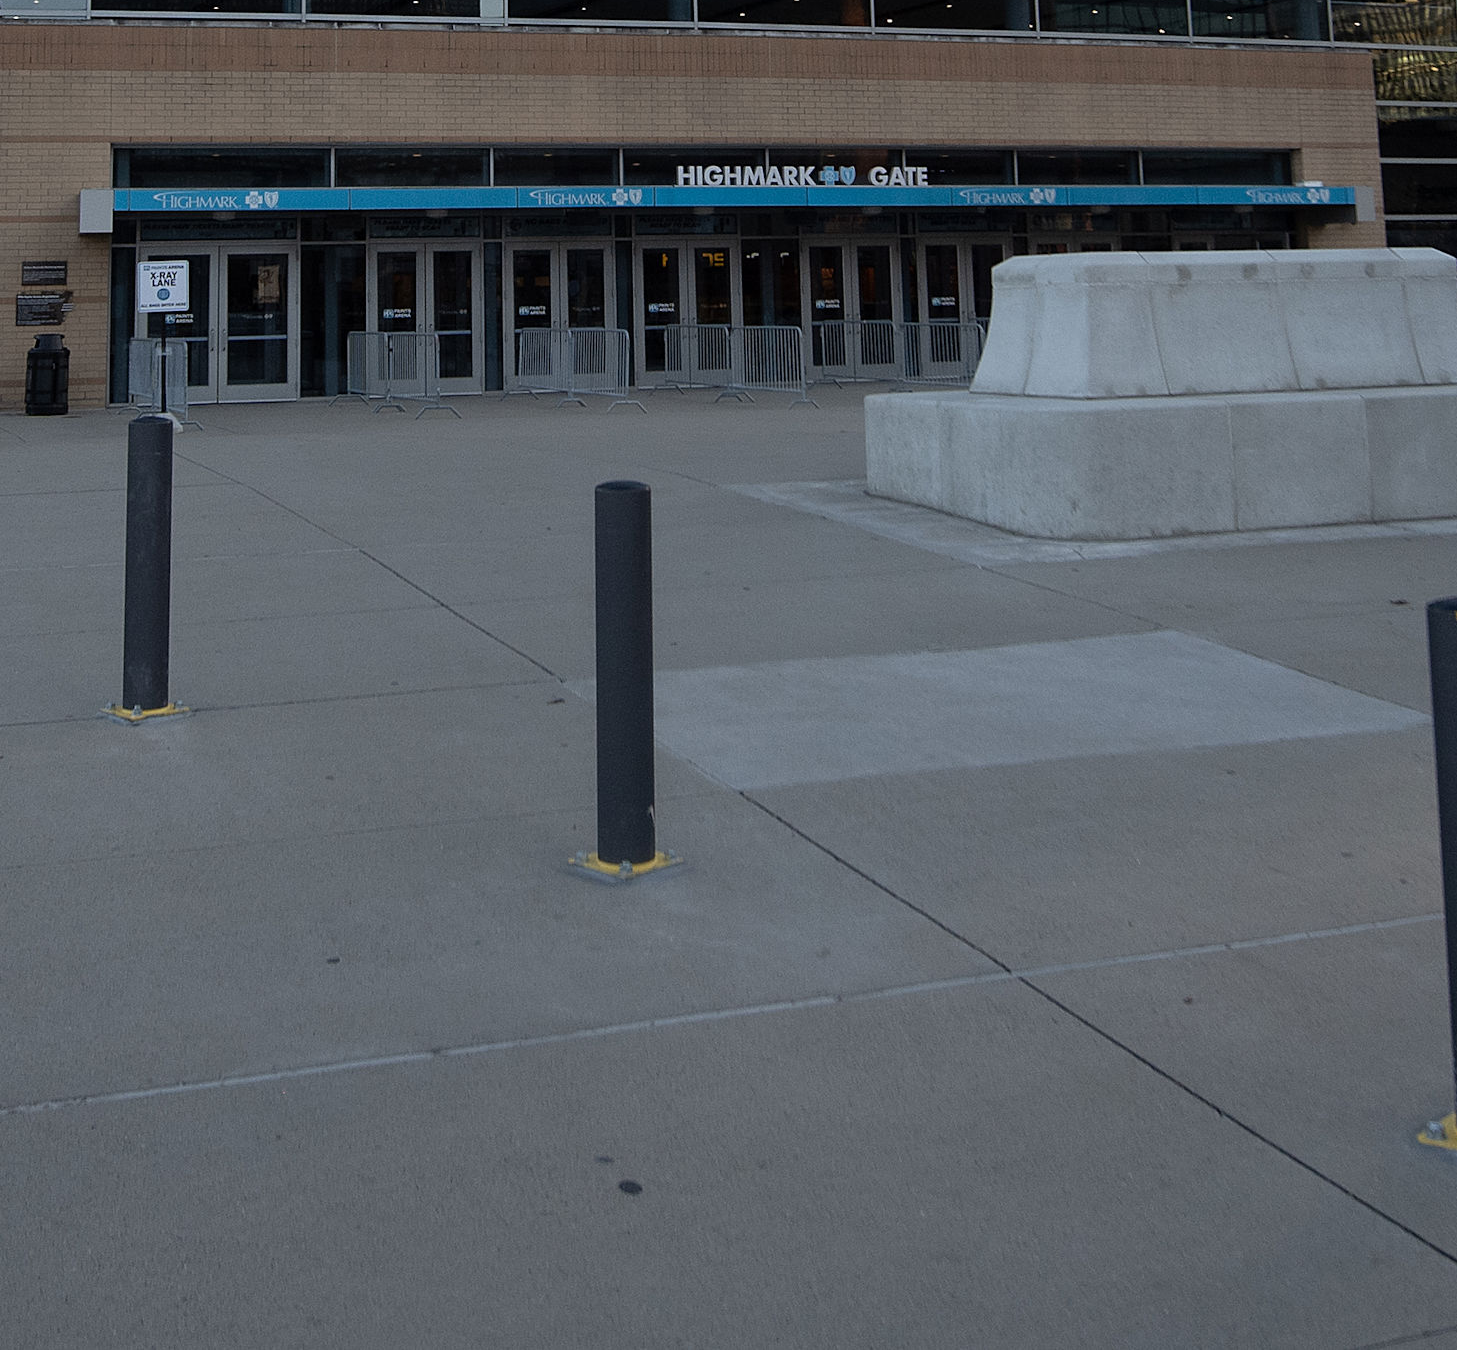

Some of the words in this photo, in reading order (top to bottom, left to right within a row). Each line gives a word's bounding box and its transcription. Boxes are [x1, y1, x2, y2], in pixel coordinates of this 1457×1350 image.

[676, 165, 817, 186] HIGHMARK
[868, 166, 929, 186] GATE
[153, 191, 240, 209] HIGHMARK
[530, 190, 607, 206] HIGHMARK
[150, 271, 178, 280] X-RAY
[151, 279, 177, 287] LANE
